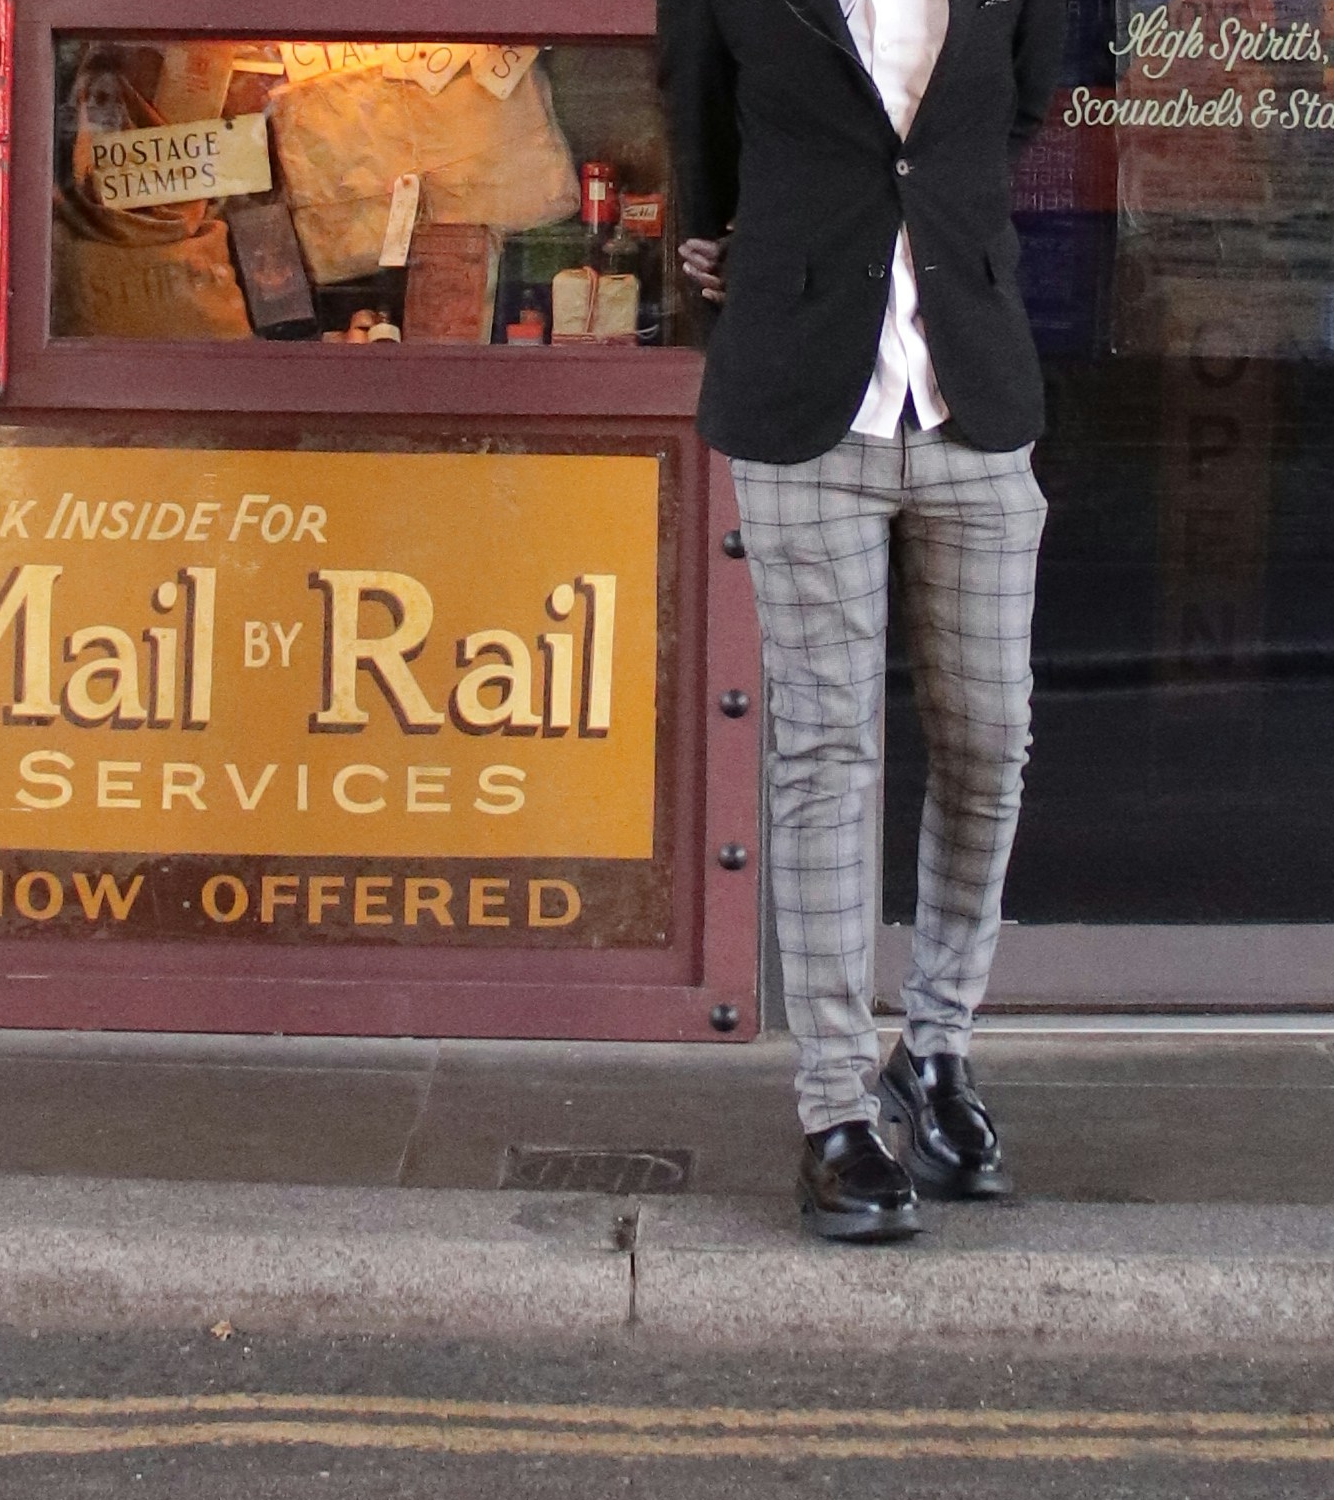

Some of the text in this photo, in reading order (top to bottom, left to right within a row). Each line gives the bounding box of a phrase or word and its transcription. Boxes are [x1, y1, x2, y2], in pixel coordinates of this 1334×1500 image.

[1109, 5, 1329, 79] High Spirits,
[1064, 86, 1243, 128] Scoundrels
[1251, 88, 1282, 127] &
[93, 132, 220, 167] POSTAGE
[103, 163, 215, 200] STAMPS
[45, 493, 221, 542] INSIDE
[229, 494, 328, 544] FOR
[244, 621, 304, 668] BY
[309, 568, 617, 737] Rail
[15, 749, 527, 814] SERVICES
[202, 874, 581, 928] OFFERED
